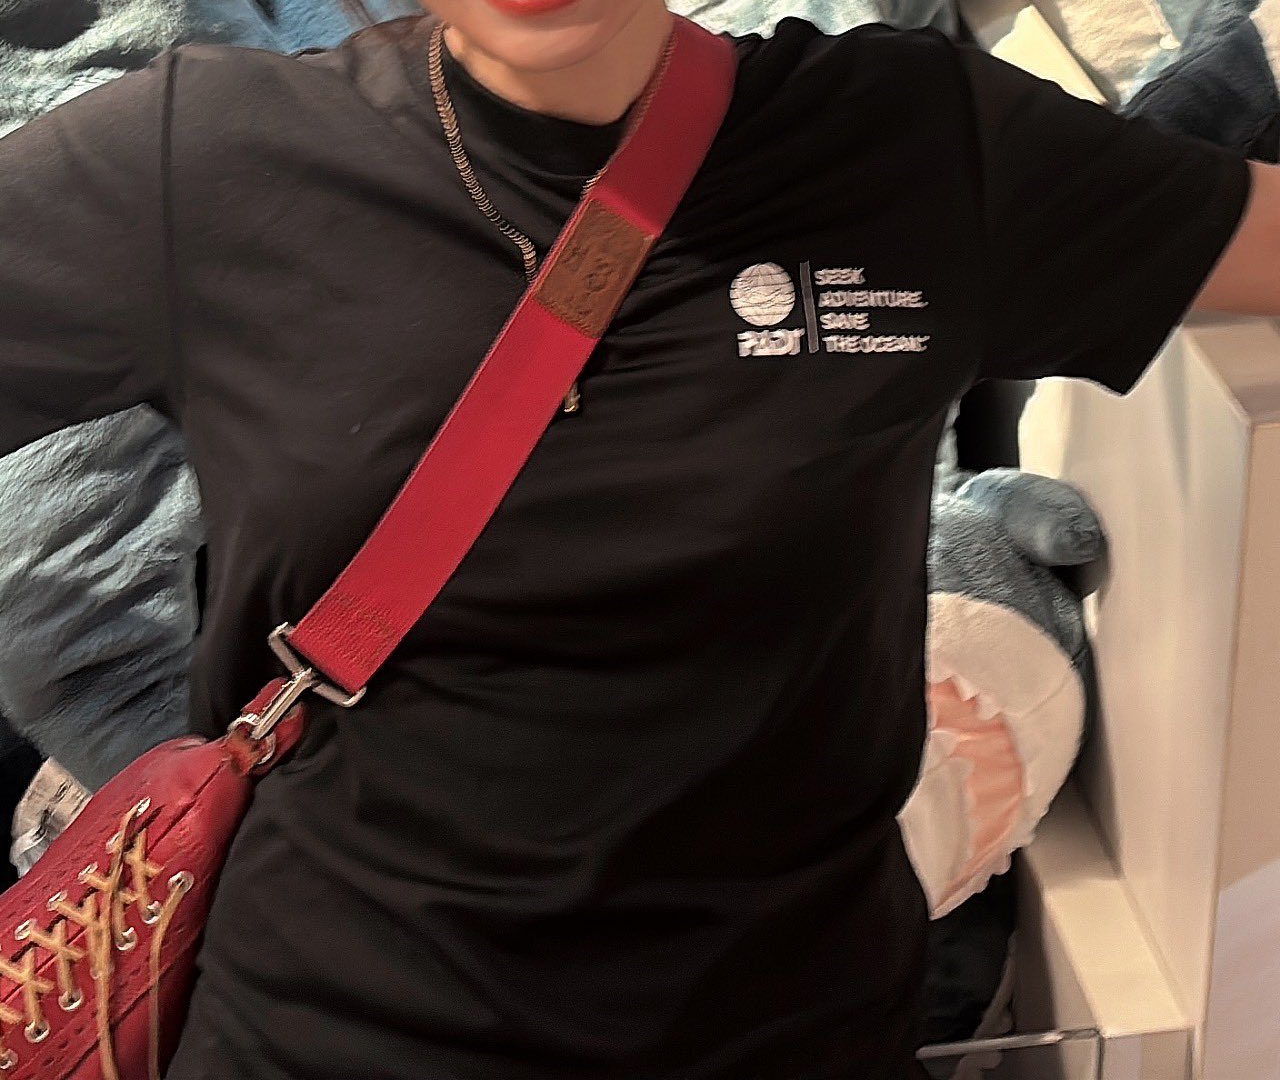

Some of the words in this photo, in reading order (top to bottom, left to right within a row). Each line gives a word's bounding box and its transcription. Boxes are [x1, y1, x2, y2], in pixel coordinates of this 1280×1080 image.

[814, 268, 866, 286] SEEK
[820, 312, 870, 330] SAVE
[822, 335, 861, 353] THE
